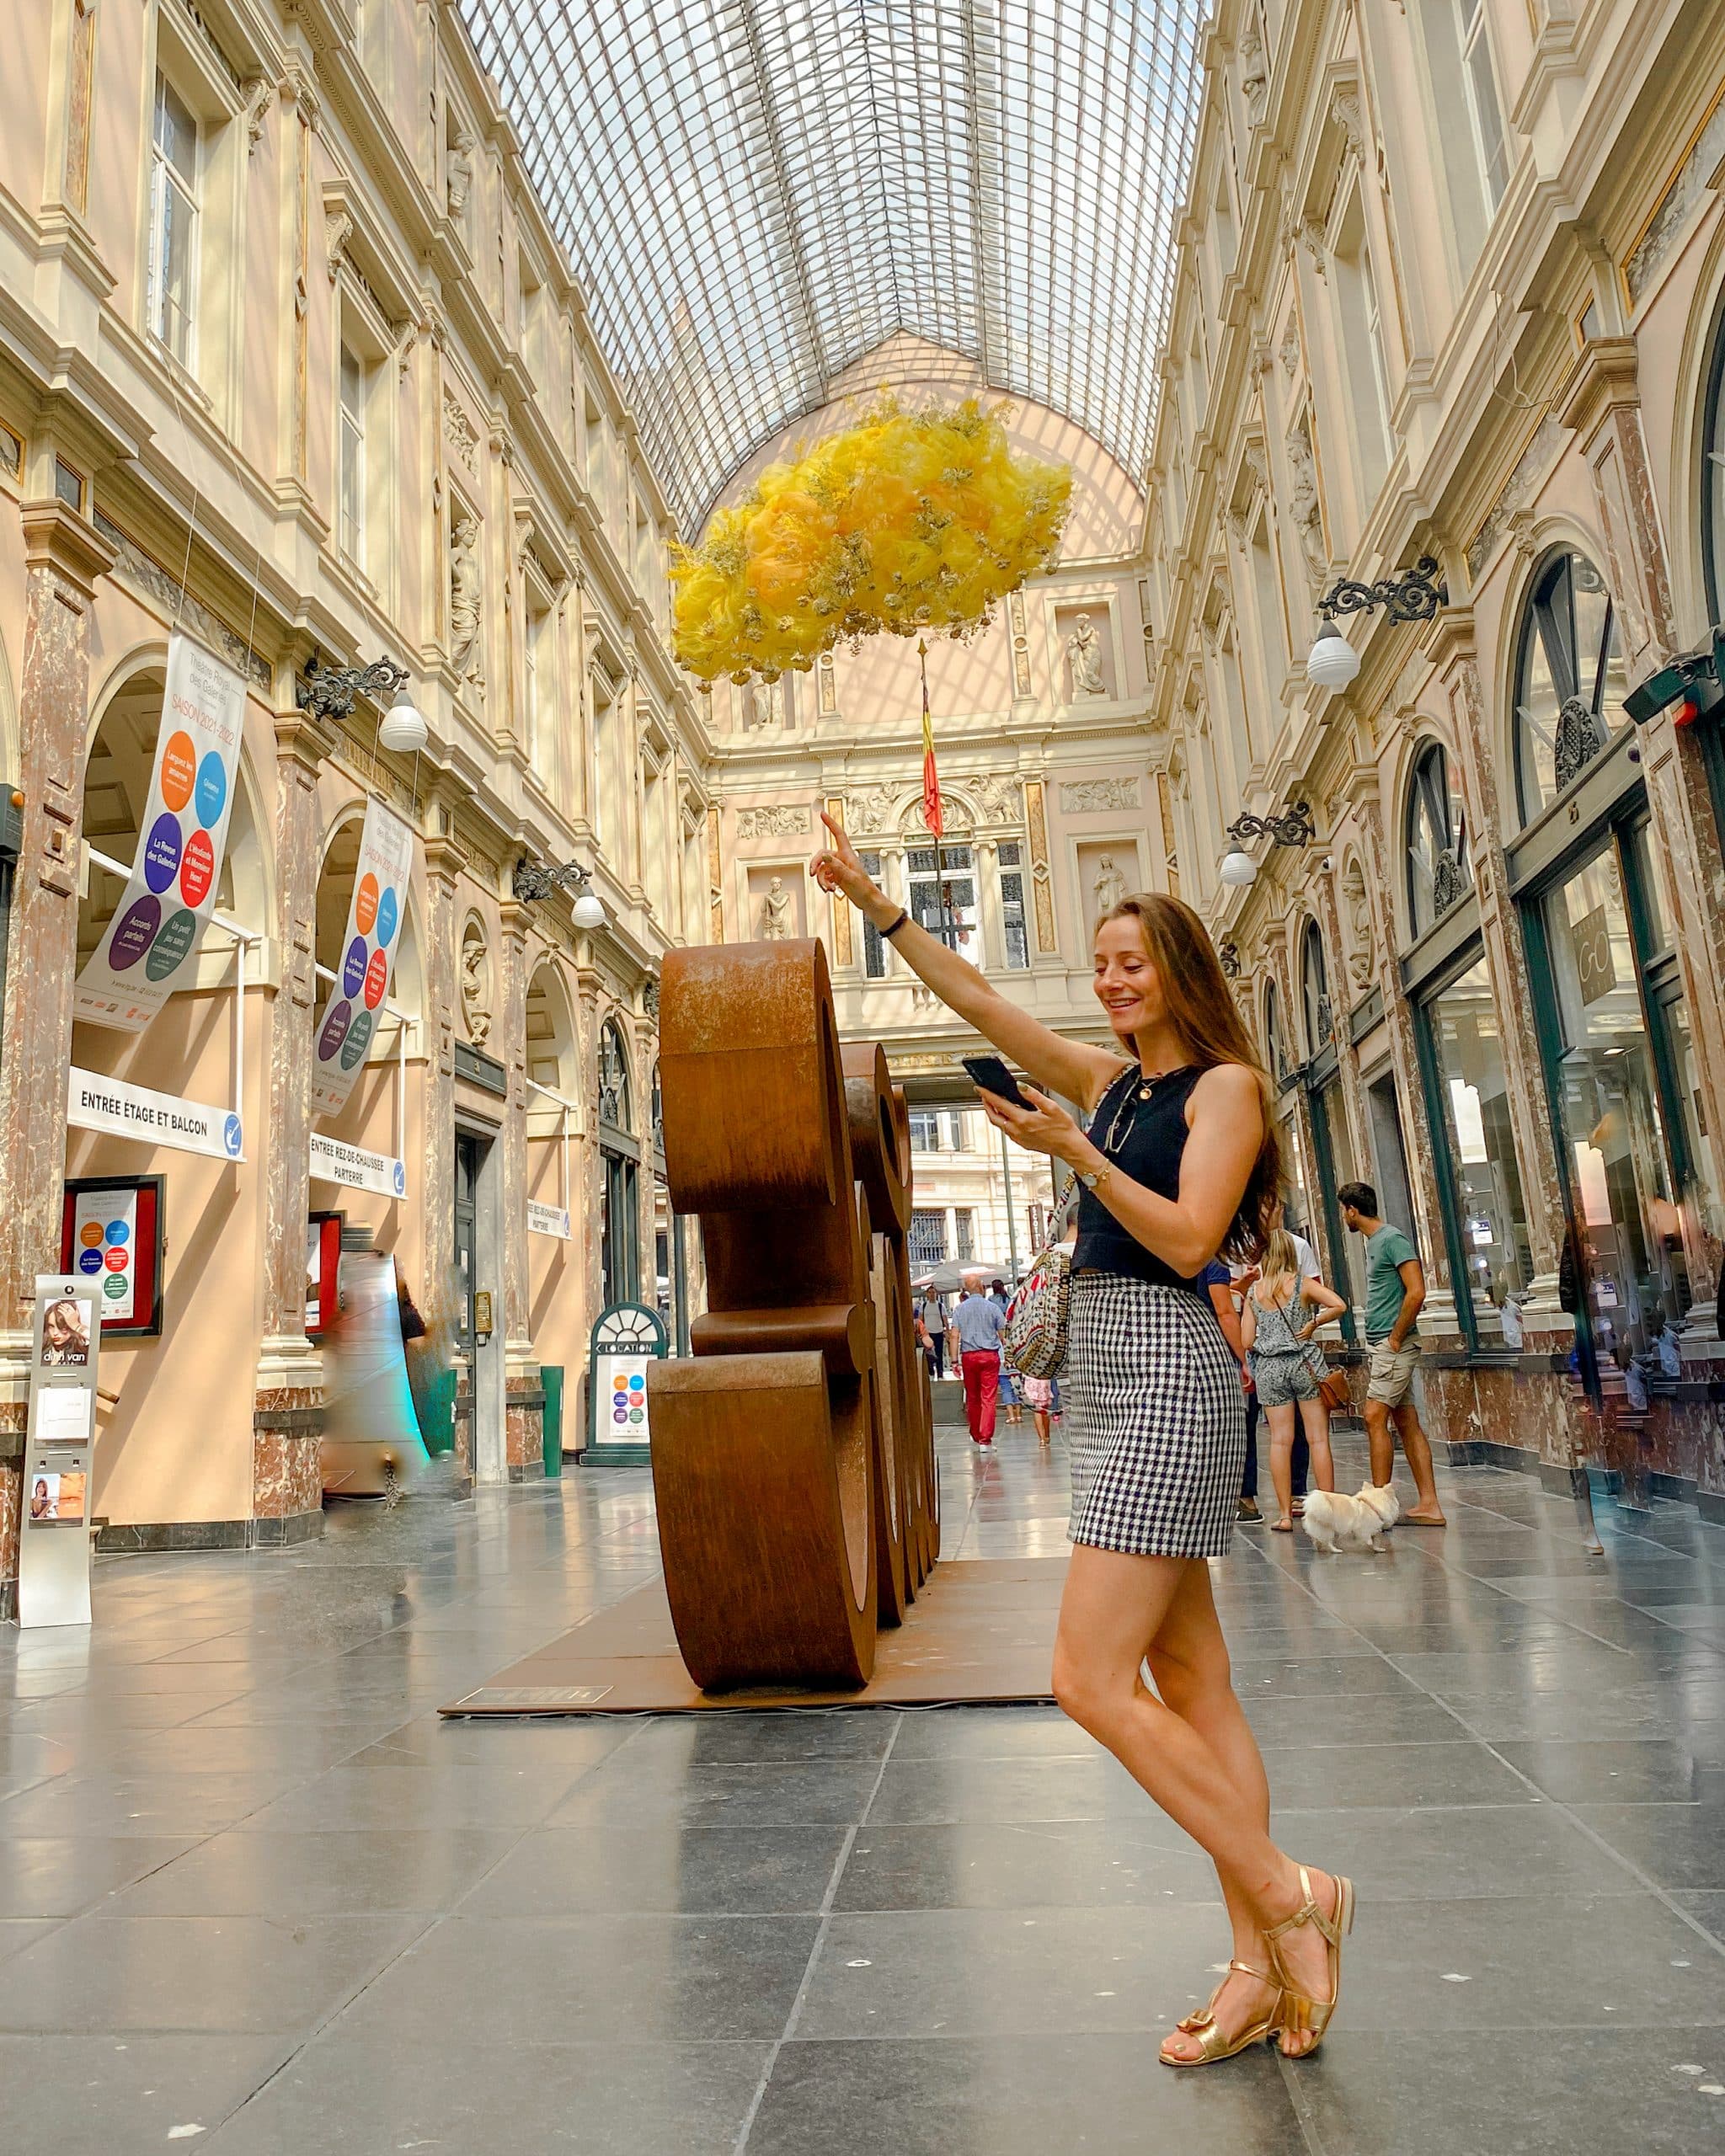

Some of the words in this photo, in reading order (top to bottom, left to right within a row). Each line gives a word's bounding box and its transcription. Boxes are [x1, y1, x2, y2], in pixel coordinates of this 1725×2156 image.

[173, 694, 199, 722] SAISON
[81, 1090, 121, 1116] ENTRÉE
[124, 1098, 154, 1124] ÉTAGE
[157, 1111, 168, 1127] ET
[171, 1114, 208, 1137] BALCON
[311, 1139, 334, 1157] ENTRÉE
[335, 1146, 385, 1171] REZ-DE-CHAUSSÉE
[334, 1166, 363, 1185] PARTERRE
[67, 1353, 85, 1362] van
[605, 1344, 652, 1353] LOCATION
